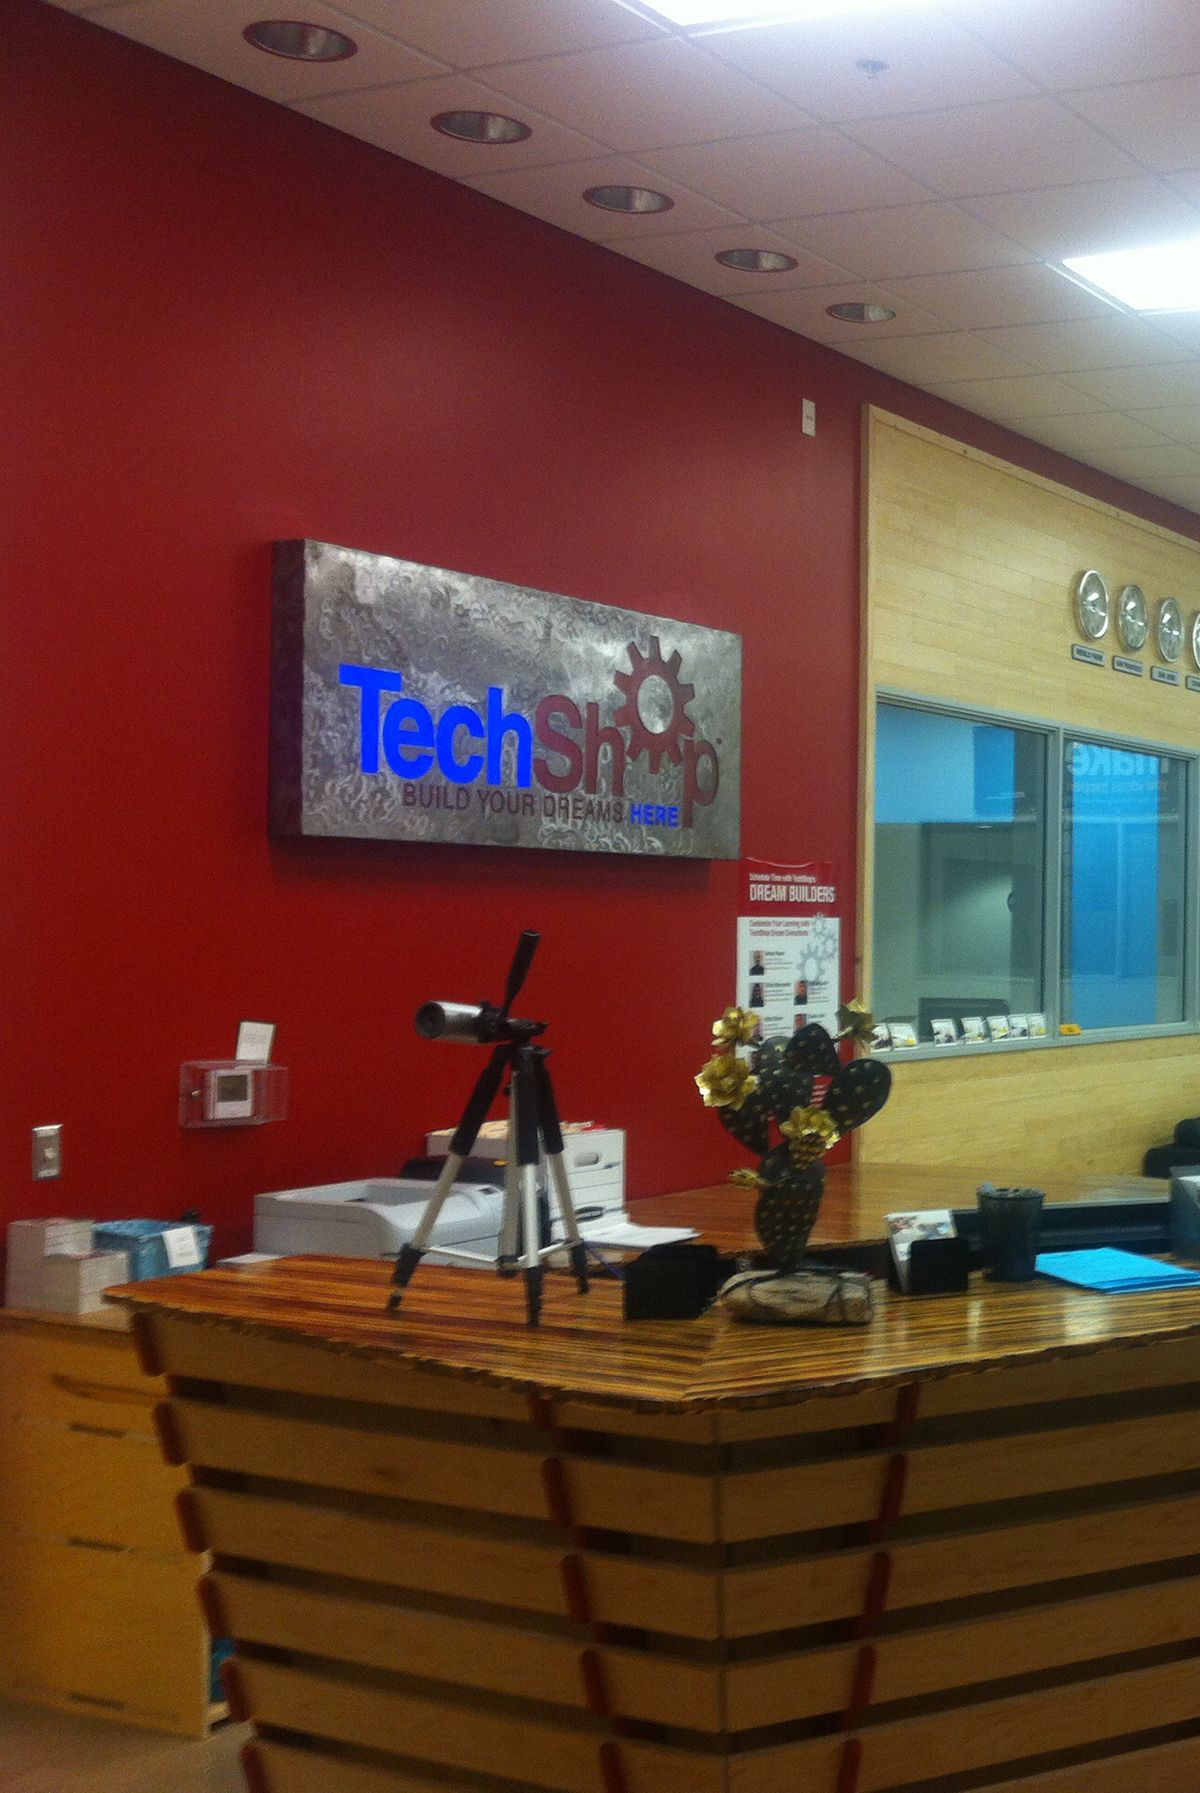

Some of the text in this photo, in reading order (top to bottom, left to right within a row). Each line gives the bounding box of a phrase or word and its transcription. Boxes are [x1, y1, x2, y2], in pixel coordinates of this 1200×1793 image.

[402, 782, 682, 828] BUILD YOUR DREAMS HERE
[749, 883, 836, 903] DREAM BUILDERS
